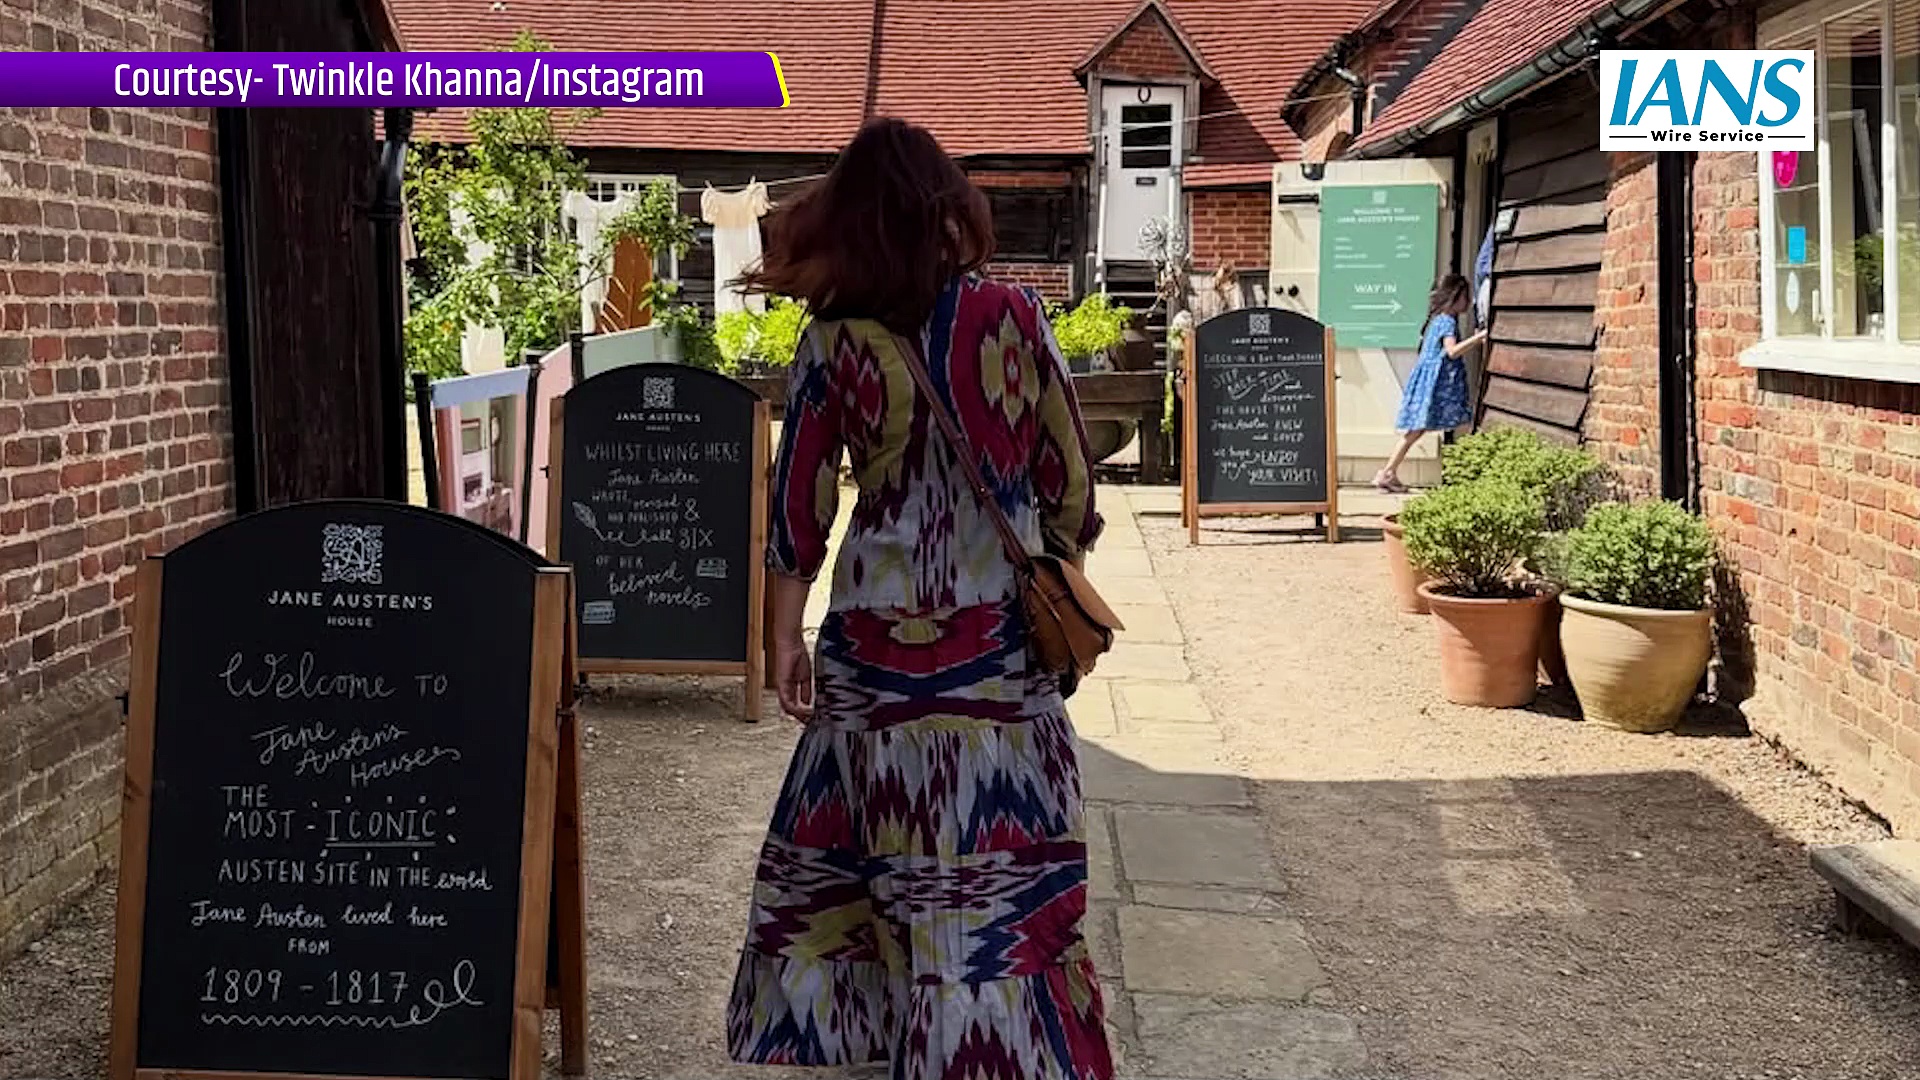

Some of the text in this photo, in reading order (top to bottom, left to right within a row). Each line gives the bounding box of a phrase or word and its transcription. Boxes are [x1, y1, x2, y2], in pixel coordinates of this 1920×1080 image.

[1353, 283, 1398, 293] WAY IN
[615, 412, 645, 422] JANE
[584, 441, 742, 464] WHILST LIVING HERE
[684, 496, 701, 523] &
[678, 526, 716, 551] SIX
[594, 555, 644, 569] OF HER
[267, 590, 433, 611] JANE AUSTEN'S
[326, 615, 374, 629] HOUSE
[218, 650, 449, 700] Welcome TO
[251, 720, 337, 765] Jane
[220, 783, 269, 808] THE
[223, 808, 437, 841] MOST ICONIC
[218, 858, 305, 884] AUSTEN
[311, 860, 359, 884] SITE
[369, 866, 391, 888] IN
[398, 866, 432, 888] THE
[189, 899, 449, 929] Jane Austen lived here
[287, 937, 331, 955] FROM
[200, 966, 283, 1004] 1809
[325, 969, 409, 1006] 1817
